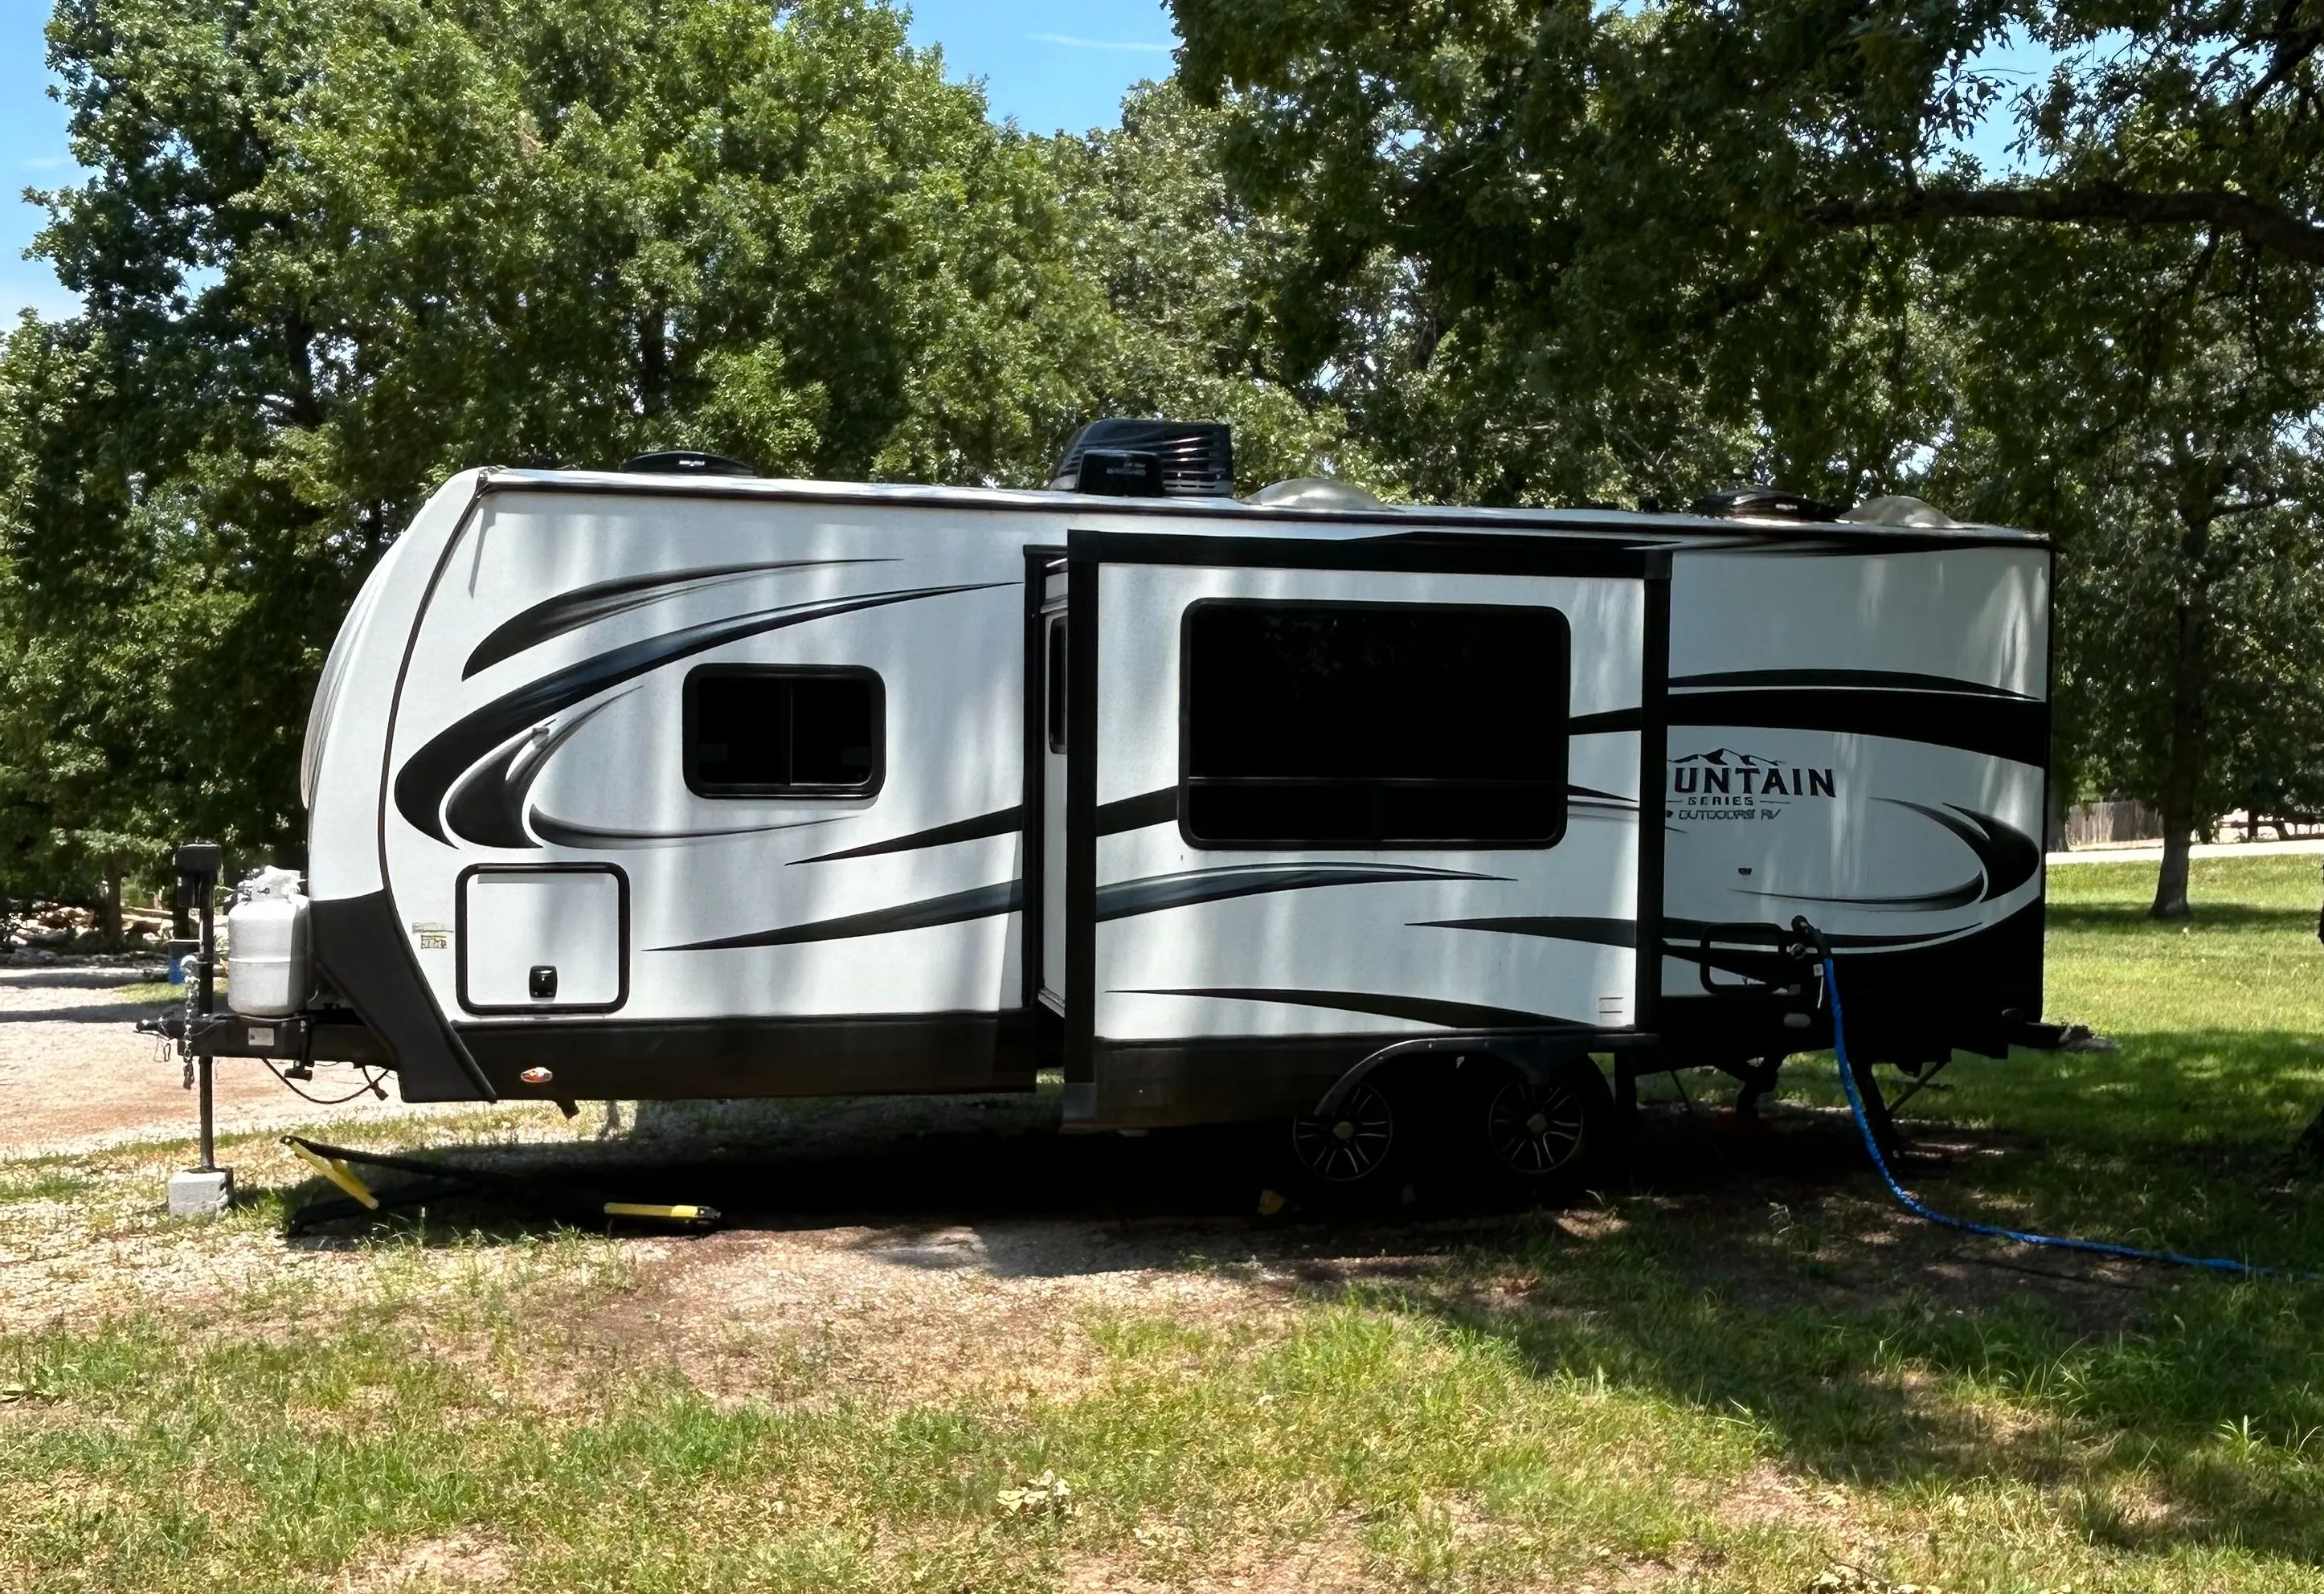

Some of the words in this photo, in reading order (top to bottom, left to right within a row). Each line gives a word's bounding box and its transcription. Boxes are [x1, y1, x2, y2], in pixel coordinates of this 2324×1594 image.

[1674, 767, 1836, 798] UNTAIN
[1688, 796, 1754, 806] SERIES
[1761, 808, 1782, 821] RV
